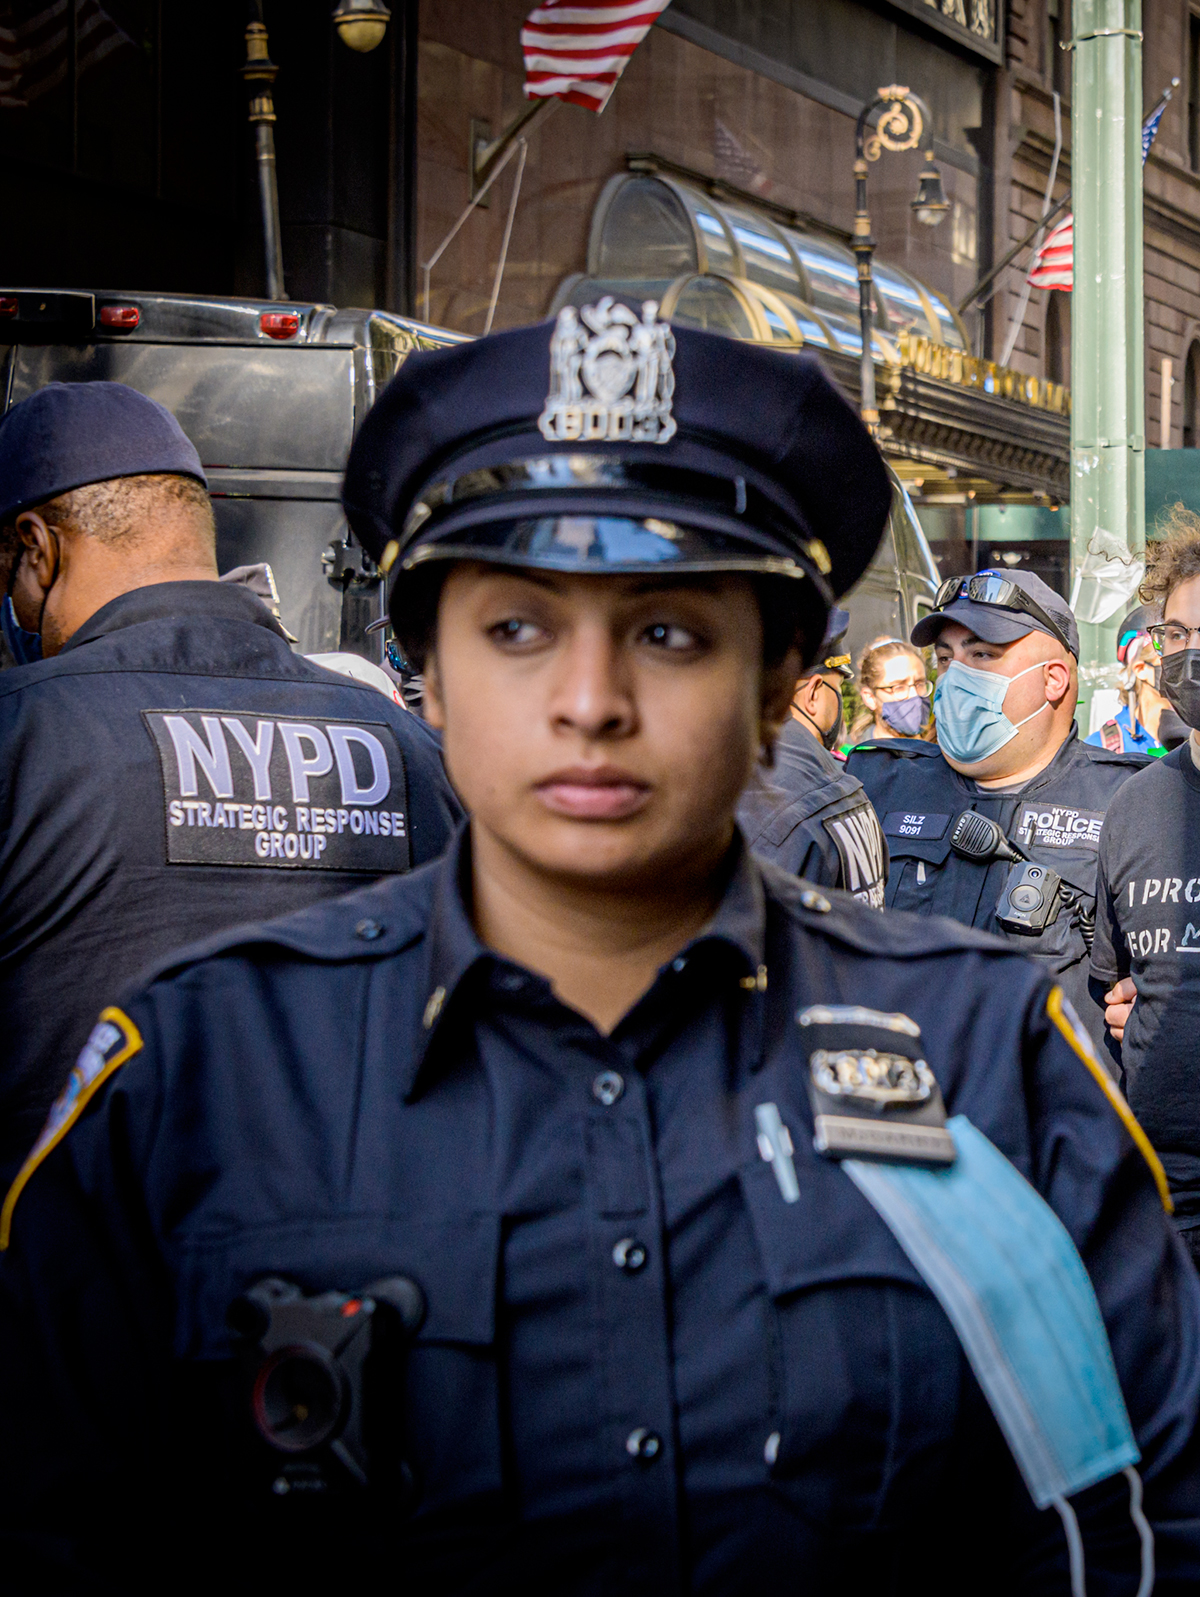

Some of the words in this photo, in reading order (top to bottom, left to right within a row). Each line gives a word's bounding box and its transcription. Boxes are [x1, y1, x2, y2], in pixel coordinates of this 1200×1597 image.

[163, 716, 391, 806] NYPD
[169, 799, 288, 832] STRATEGIC
[296, 806, 406, 837] RESPONSE
[903, 814, 925, 825] SILZ
[1022, 811, 1103, 836] POLICE
[1052, 807, 1079, 819] NYPD
[898, 824, 922, 835] 9091
[1018, 827, 1061, 839] STTEGIC
[1043, 835, 1075, 846] GROUP
[255, 831, 327, 860] GROUP
[1128, 881, 1136, 908] I
[1126, 928, 1172, 958] FOR
